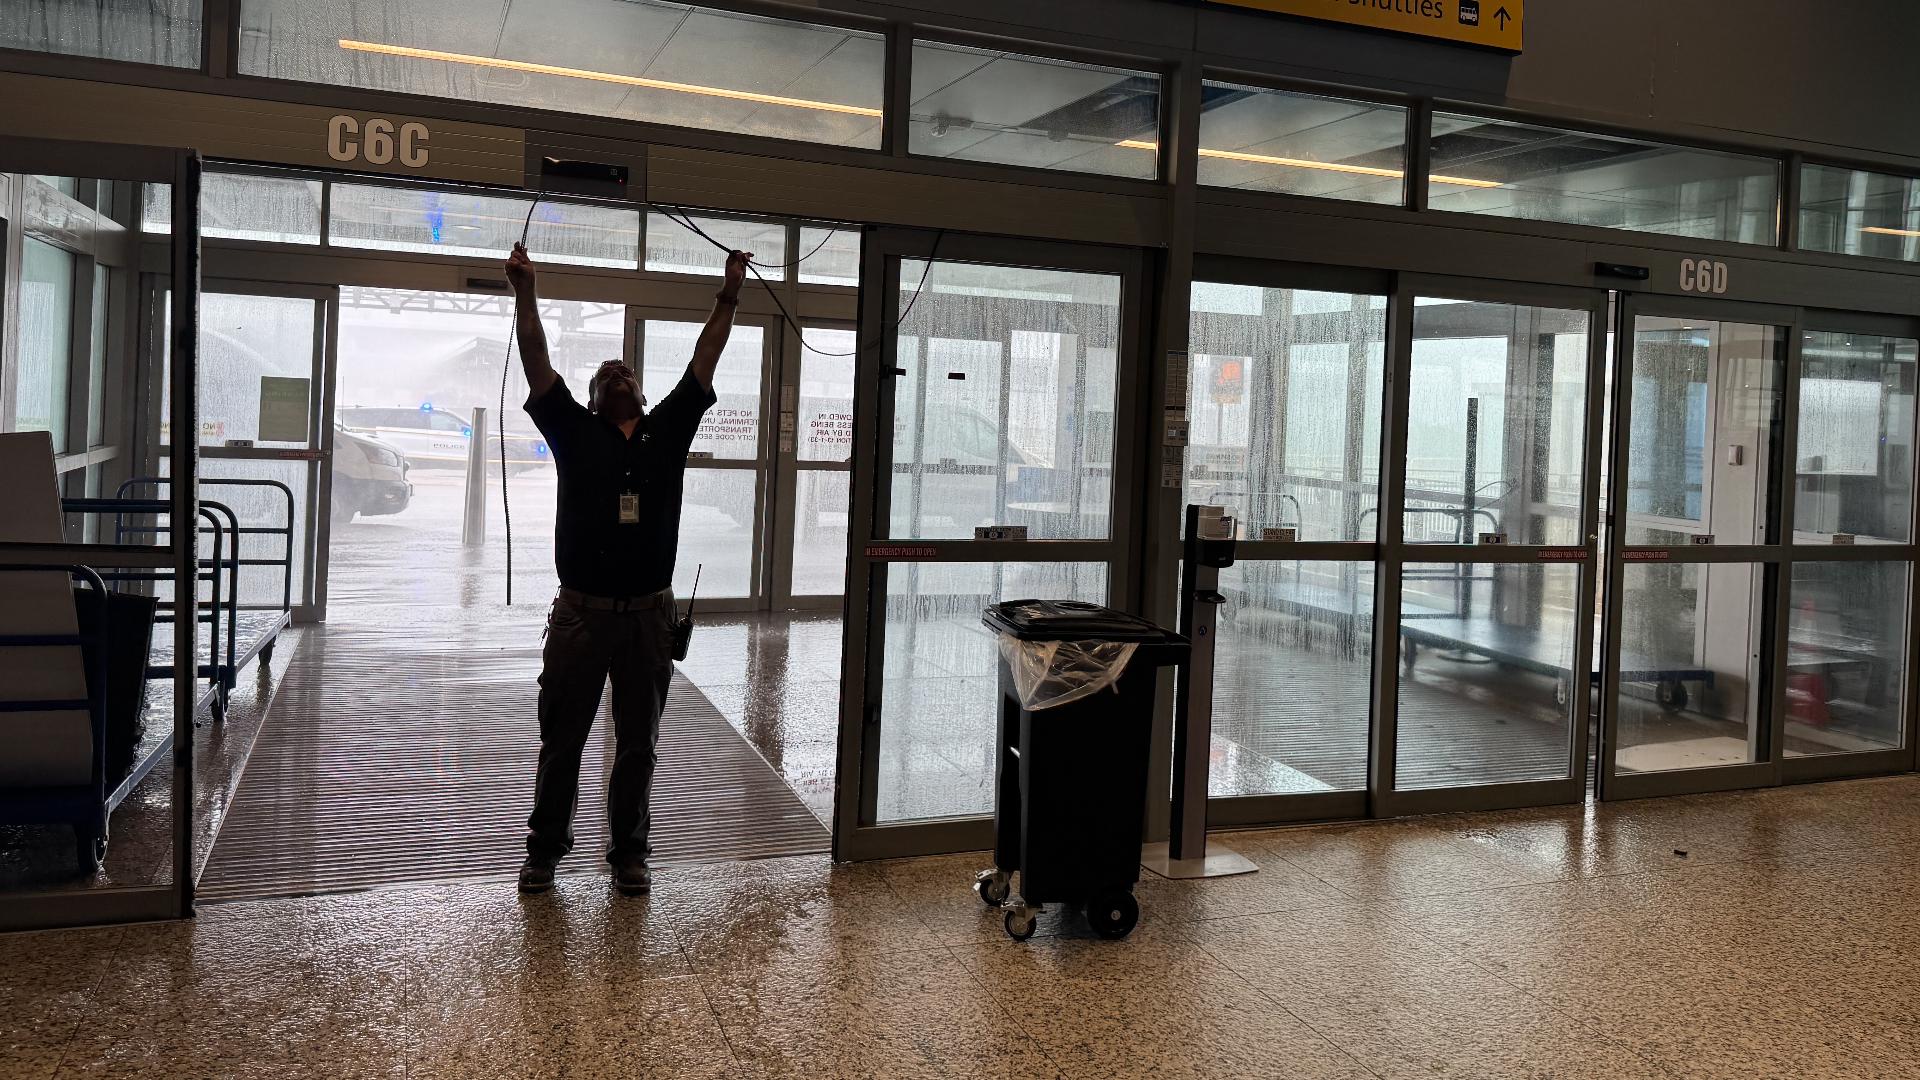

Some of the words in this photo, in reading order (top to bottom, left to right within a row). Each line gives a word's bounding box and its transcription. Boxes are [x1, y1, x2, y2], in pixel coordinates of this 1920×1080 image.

[1348, 0, 1443, 19] uttles
[327, 114, 430, 169] C6C
[1679, 258, 1728, 294] C6D
